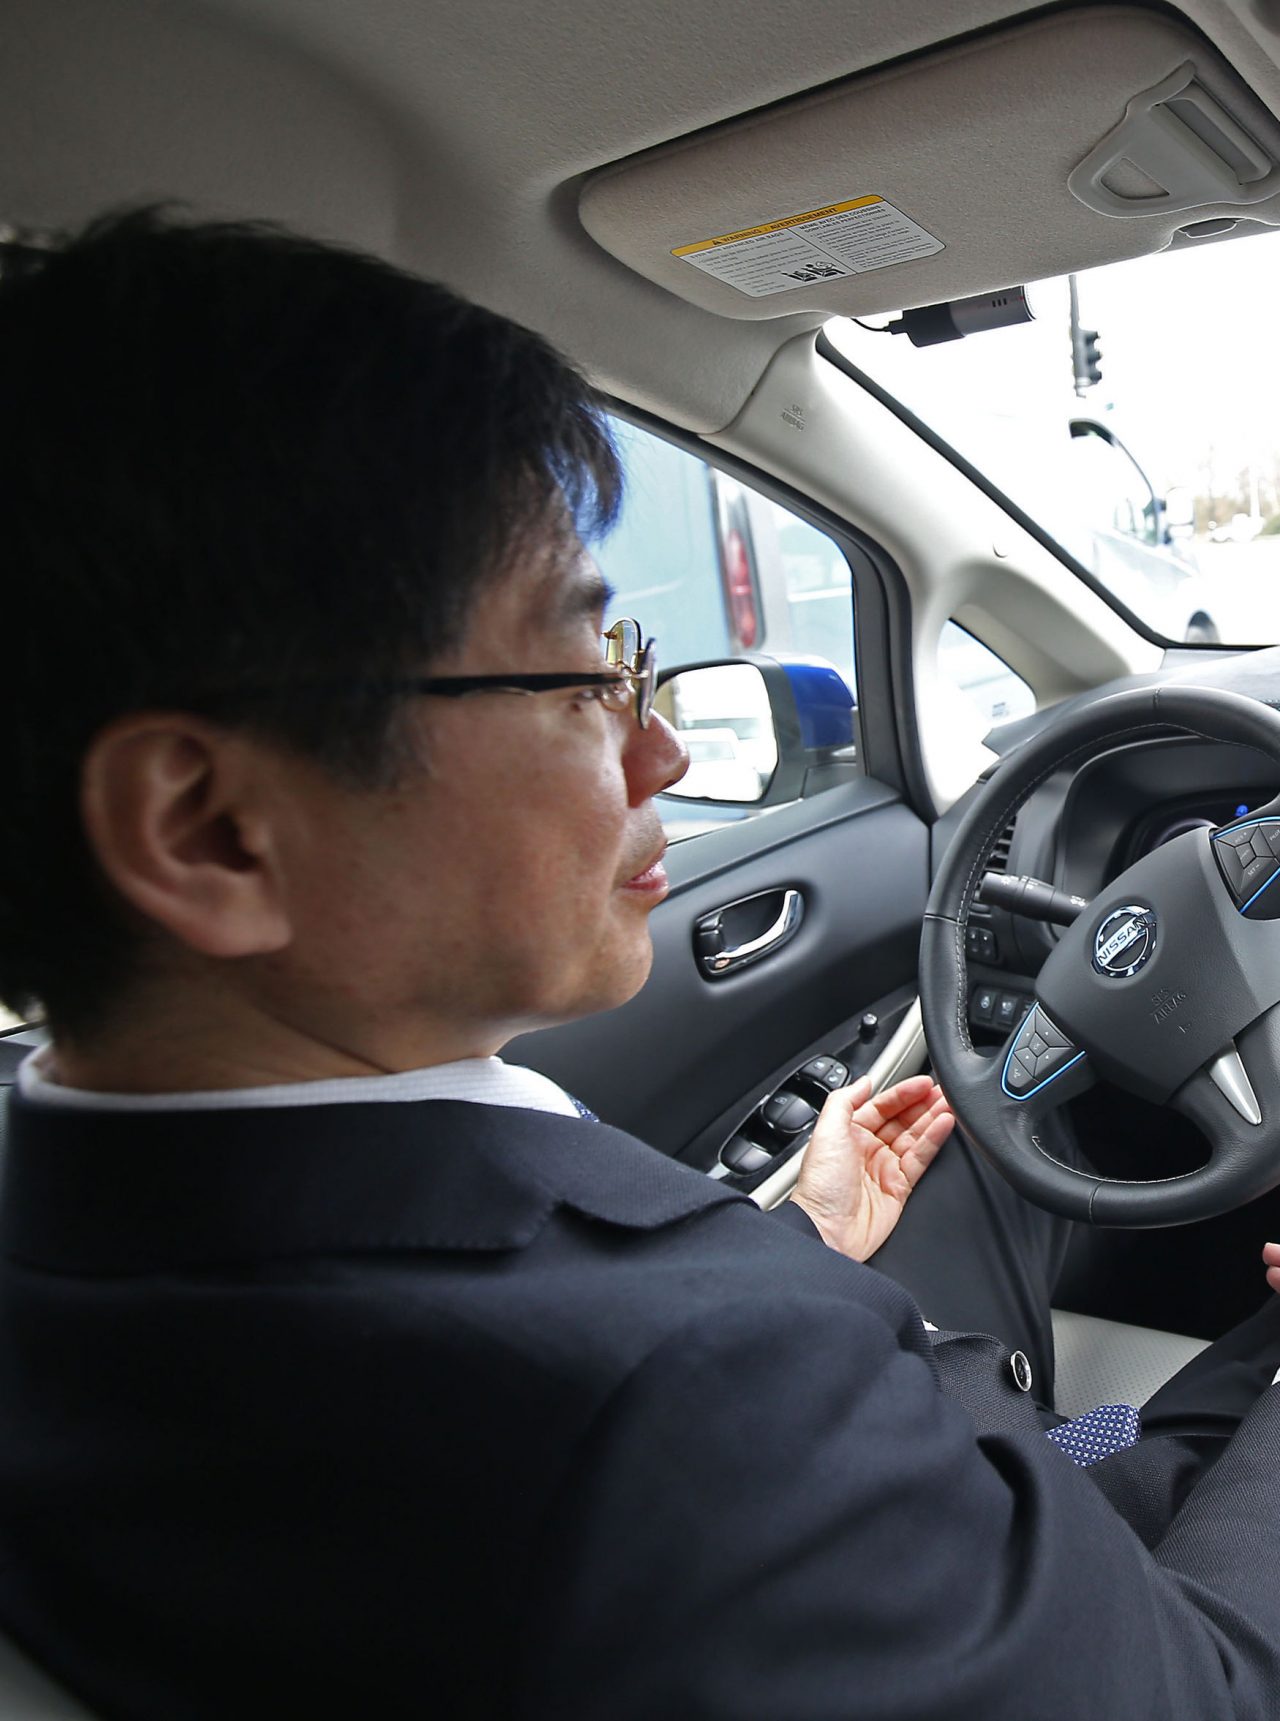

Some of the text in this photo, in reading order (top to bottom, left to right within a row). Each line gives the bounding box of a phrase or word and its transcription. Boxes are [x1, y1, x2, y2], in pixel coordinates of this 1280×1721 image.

[724, 228, 762, 243] WARNING
[770, 207, 837, 230] AVERTISSEMENT
[1098, 915, 1149, 964] NISSAN
